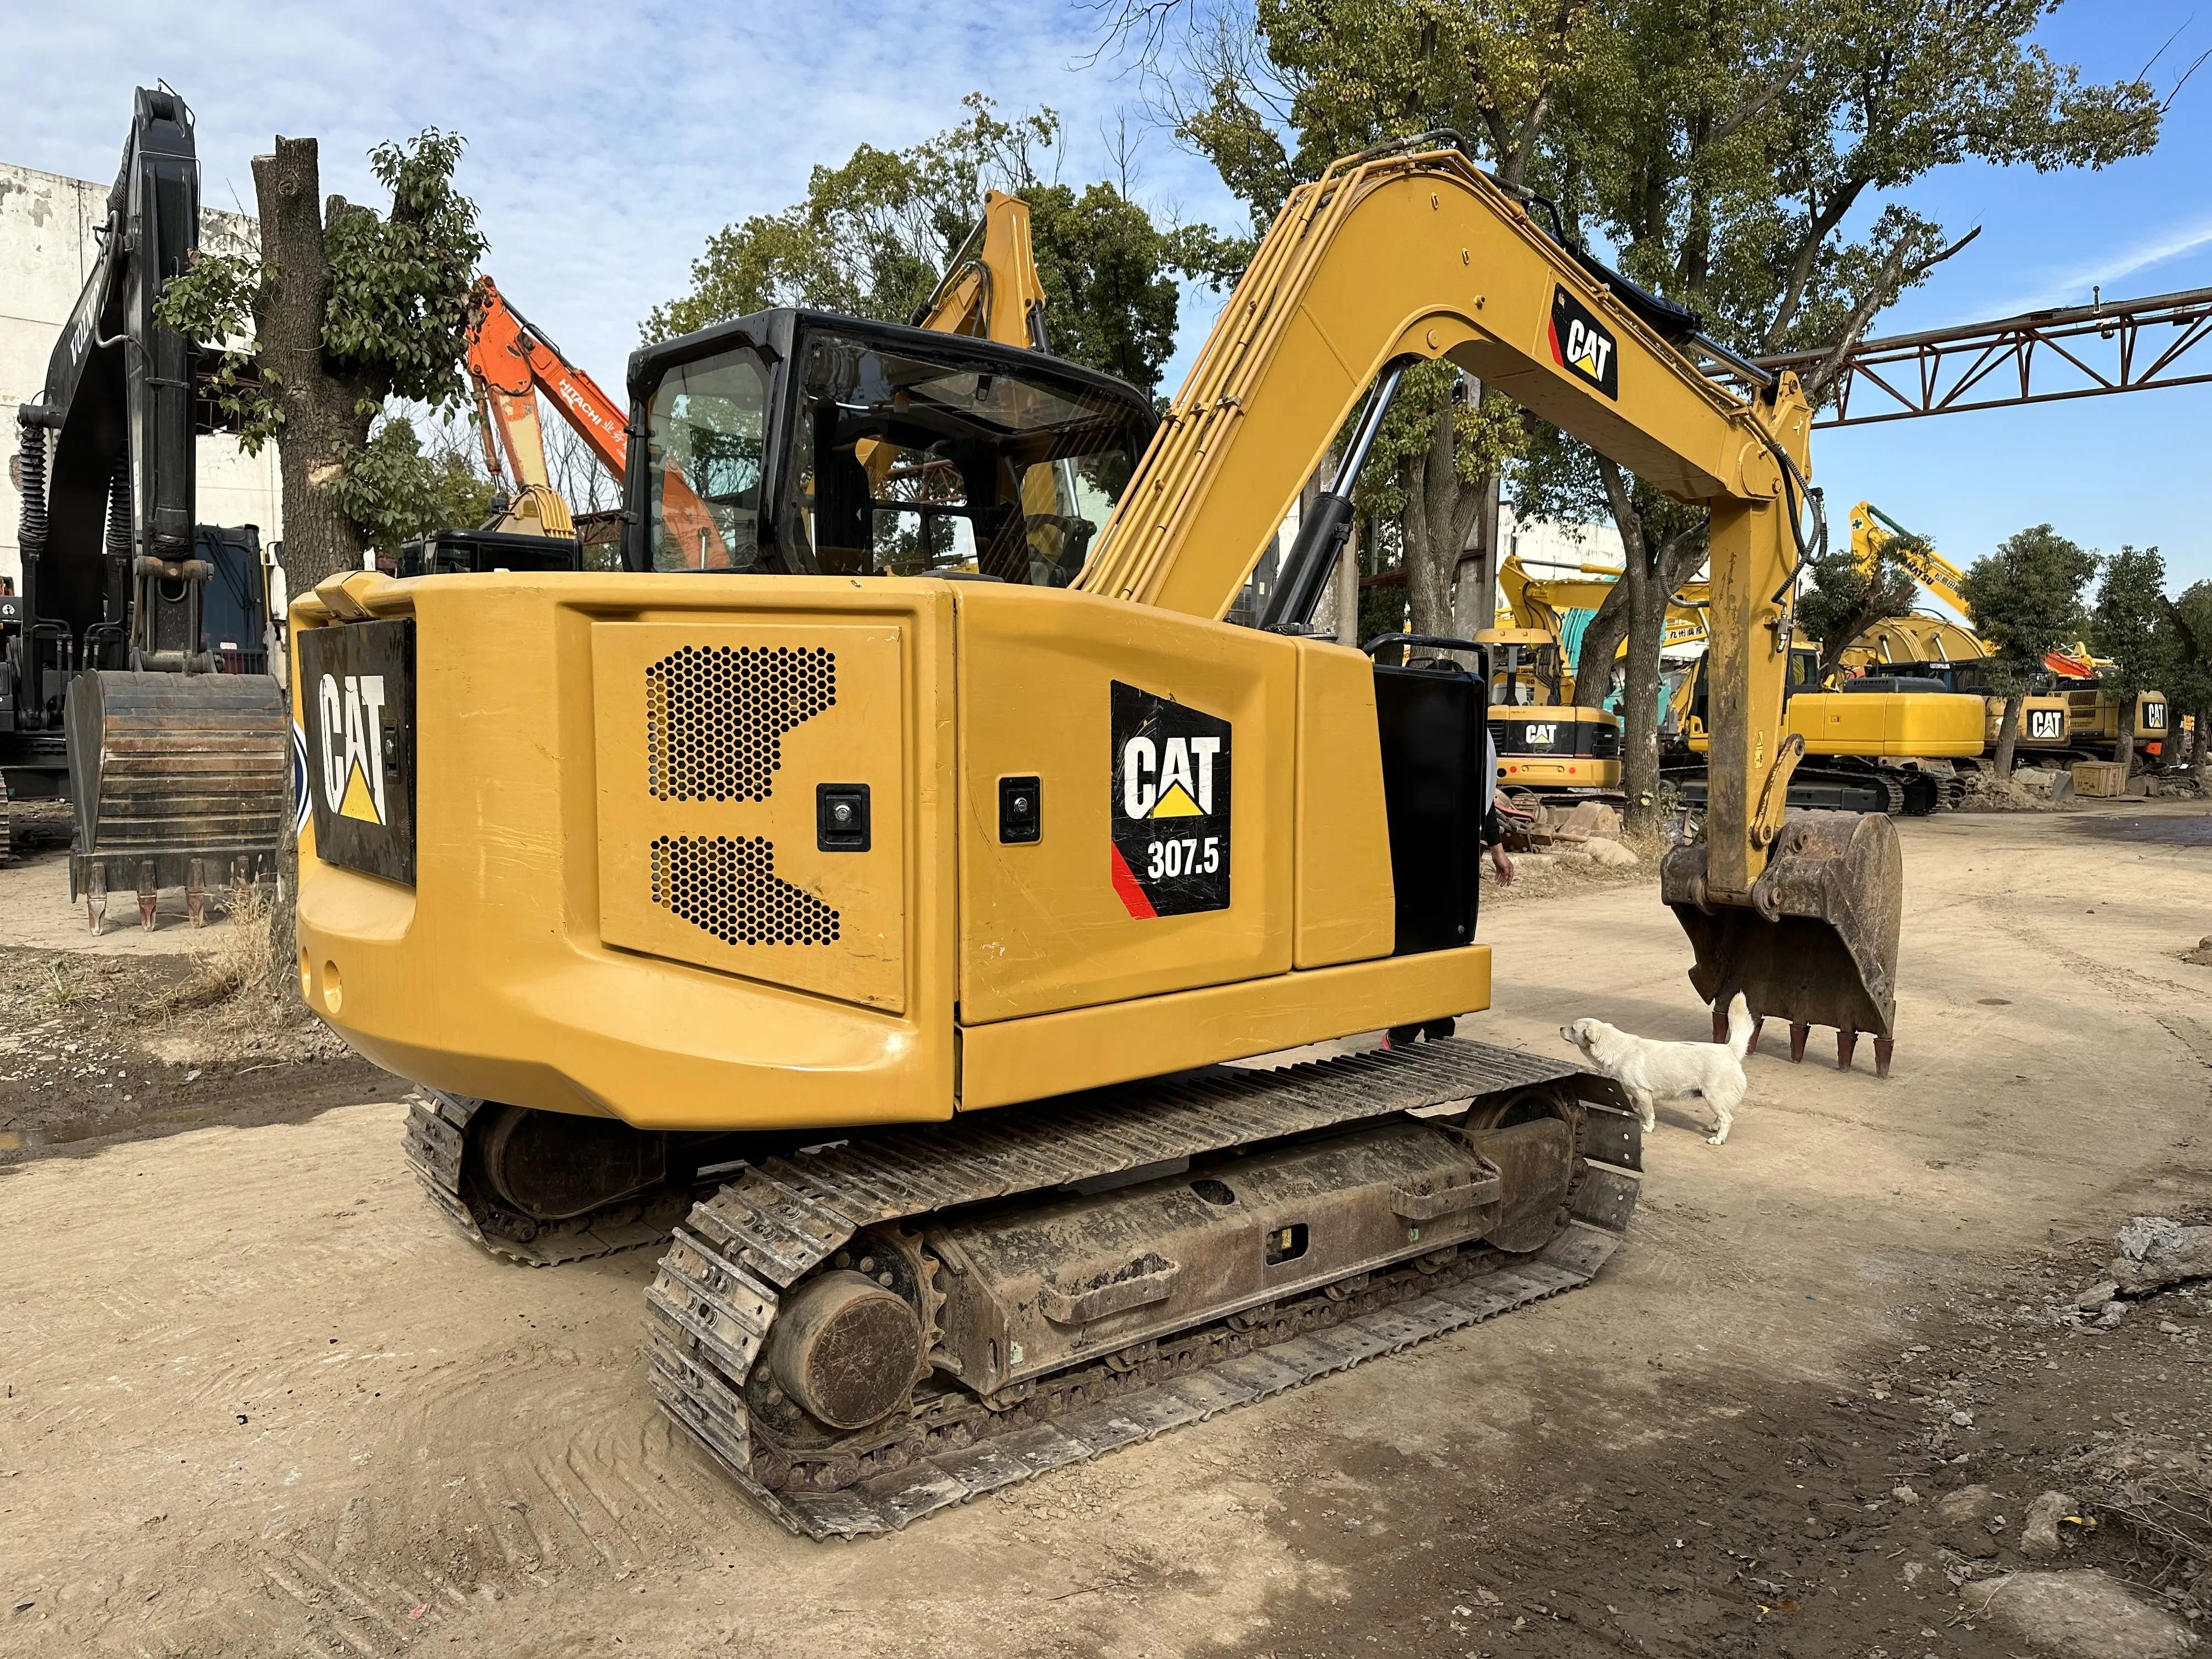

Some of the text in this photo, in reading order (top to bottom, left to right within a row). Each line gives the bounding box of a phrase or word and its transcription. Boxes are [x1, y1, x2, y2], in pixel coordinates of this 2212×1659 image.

[1567, 319, 1611, 382] CAT
[558, 379, 602, 426] HITACHI
[1905, 561, 1934, 585] MATSU
[1526, 724, 1556, 744] CAT
[2033, 712, 2061, 738] CAT
[2148, 703, 2164, 728] CAT
[319, 673, 386, 826] CAT
[1125, 736, 1220, 820] CAT
[1148, 837, 1219, 879] 307.5
